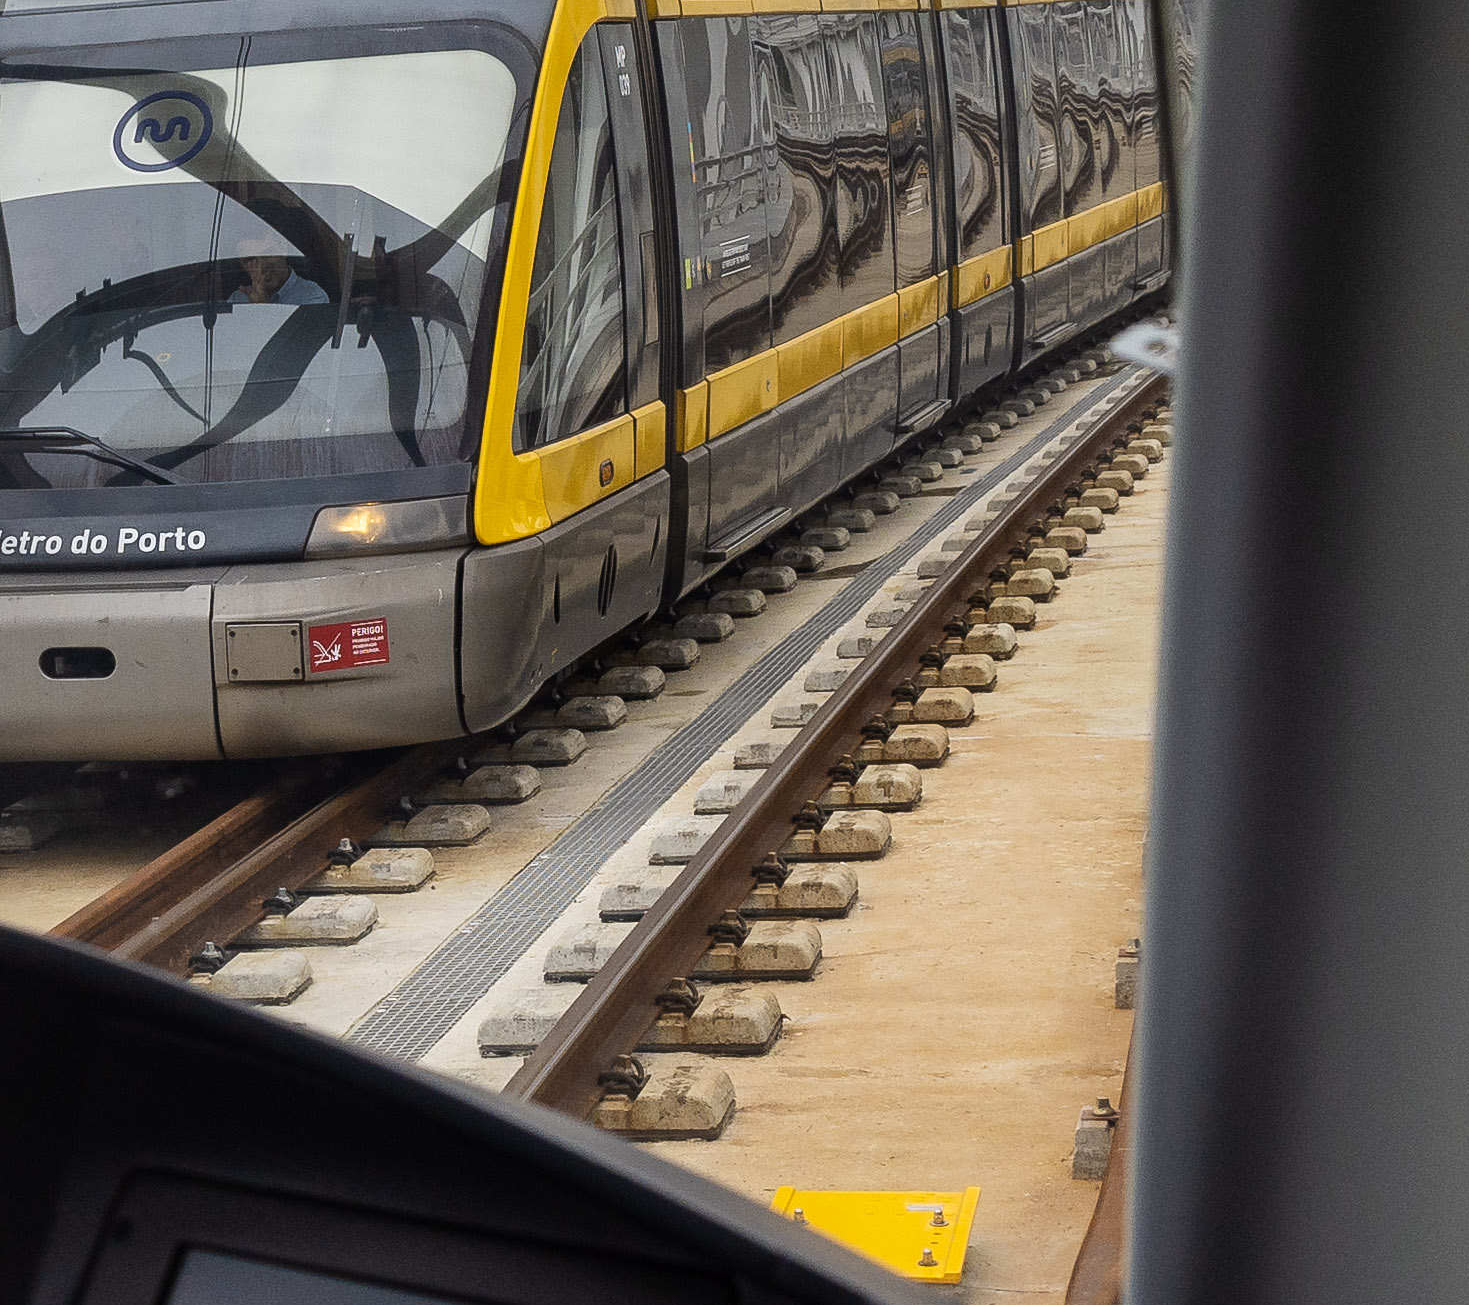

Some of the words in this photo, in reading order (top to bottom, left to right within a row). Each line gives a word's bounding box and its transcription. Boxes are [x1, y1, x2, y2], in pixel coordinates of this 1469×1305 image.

[71, 528, 107, 554] do
[117, 526, 206, 554] Porto
[351, 624, 384, 637] PERIGO!
